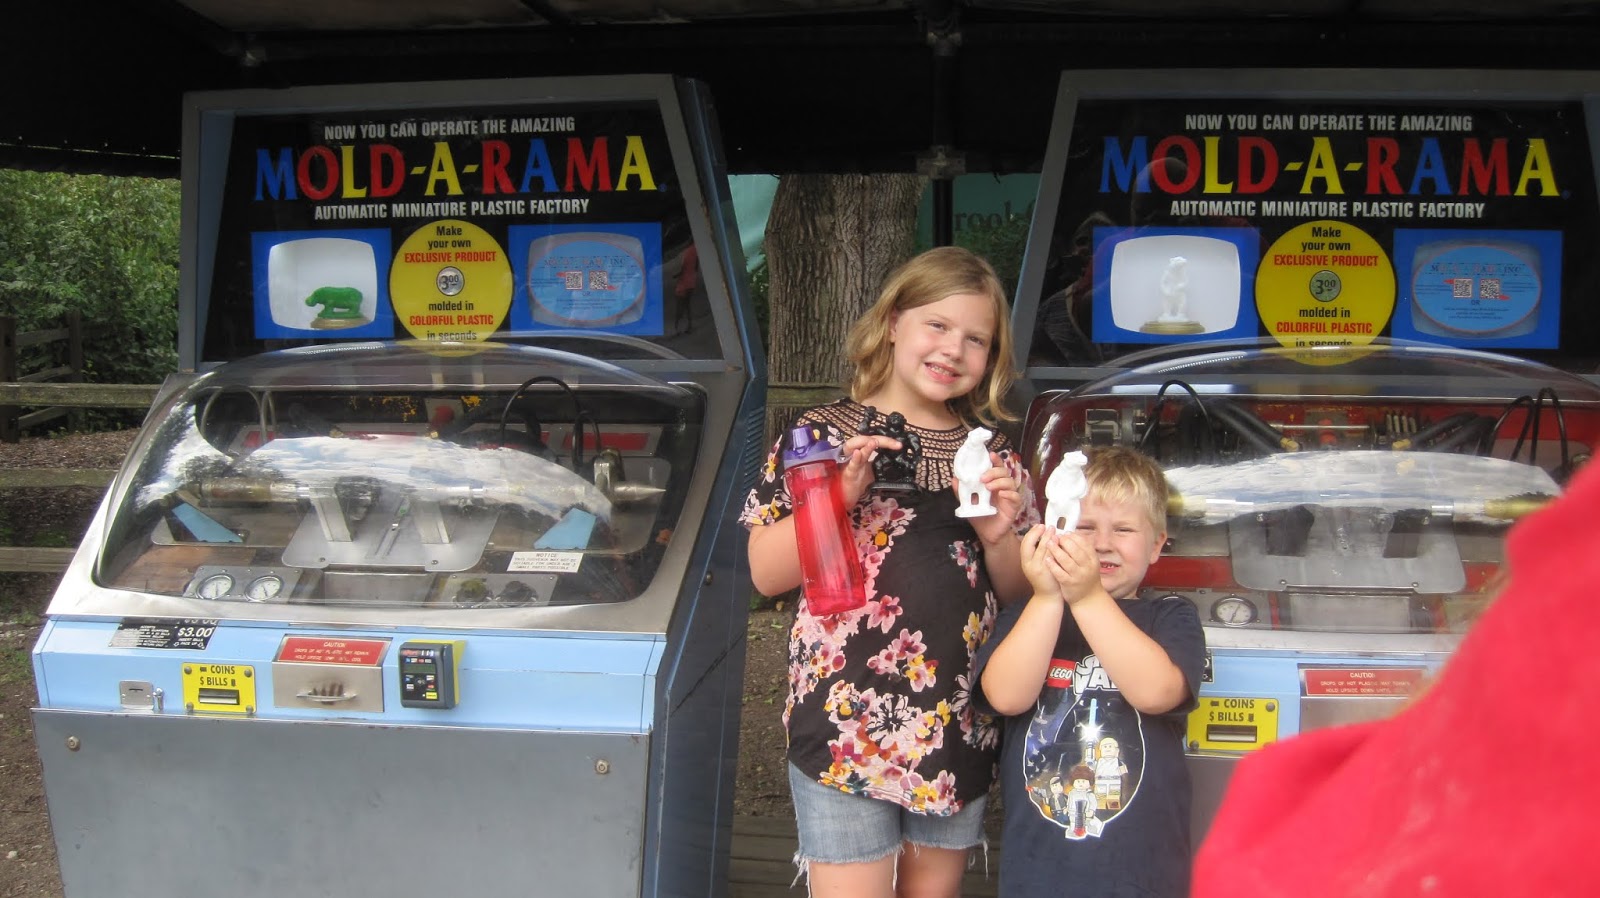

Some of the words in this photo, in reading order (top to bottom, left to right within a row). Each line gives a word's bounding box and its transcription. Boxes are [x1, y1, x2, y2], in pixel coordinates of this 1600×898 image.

[324, 125, 356, 140] NOW
[360, 123, 386, 139] YOU
[390, 122, 417, 138] CAN
[421, 119, 477, 137] OPERATE
[482, 118, 507, 135] THE
[510, 116, 576, 134] AMAZING
[1185, 114, 1223, 130] NOW
[1228, 114, 1258, 130] YOU
[1262, 114, 1294, 130] CAN
[1299, 114, 1364, 131] OPERATE
[1368, 114, 1396, 131] THE
[1400, 115, 1473, 132] AMAZING
[255, 135, 659, 201] MOLD-A-RAMA
[1099, 134, 1560, 198] MOLD-A-RAMA
[314, 203, 388, 220] AUTOMATIC
[392, 201, 467, 218] MINIATURE
[471, 199, 526, 216] PLASTIC
[530, 198, 590, 215] FACTORY
[1170, 200, 1256, 217] AUTOMATIC
[1261, 200, 1348, 218] MINIATURE
[1352, 201, 1413, 218] PLASTIC
[1418, 202, 1486, 219] FACTORY
[436, 225, 463, 236] Make
[1311, 226, 1341, 238] Make
[428, 240, 449, 251] your
[451, 239, 472, 248] own
[1301, 242, 1326, 253] your
[1328, 241, 1351, 251] own
[404, 252, 452, 264] EXCLUSIVE
[455, 251, 497, 263] PRODUCT
[1273, 254, 1329, 267] EXCLUSIVE
[1331, 255, 1379, 267] PRODUCT
[428, 300, 463, 311] molded
[465, 300, 474, 311] in
[1298, 306, 1338, 318] molded
[1340, 306, 1351, 318] in
[409, 315, 455, 326] COLORFUL
[457, 314, 494, 326] PLASTIC
[1276, 321, 1328, 333] COLORFUL
[1331, 322, 1373, 334] PLASTIC
[426, 330, 436, 341] in
[438, 330, 477, 341] seconds
[1295, 337, 1306, 347] in
[177, 627, 213, 637] $3.00
[210, 665, 236, 675] COINS
[1050, 667, 1073, 679] LEGO
[199, 676, 205, 685] $
[206, 677, 228, 686] BILLS
[1223, 698, 1255, 709] COINS
[1209, 712, 1215, 722] $
[1217, 711, 1245, 722] BILLS
